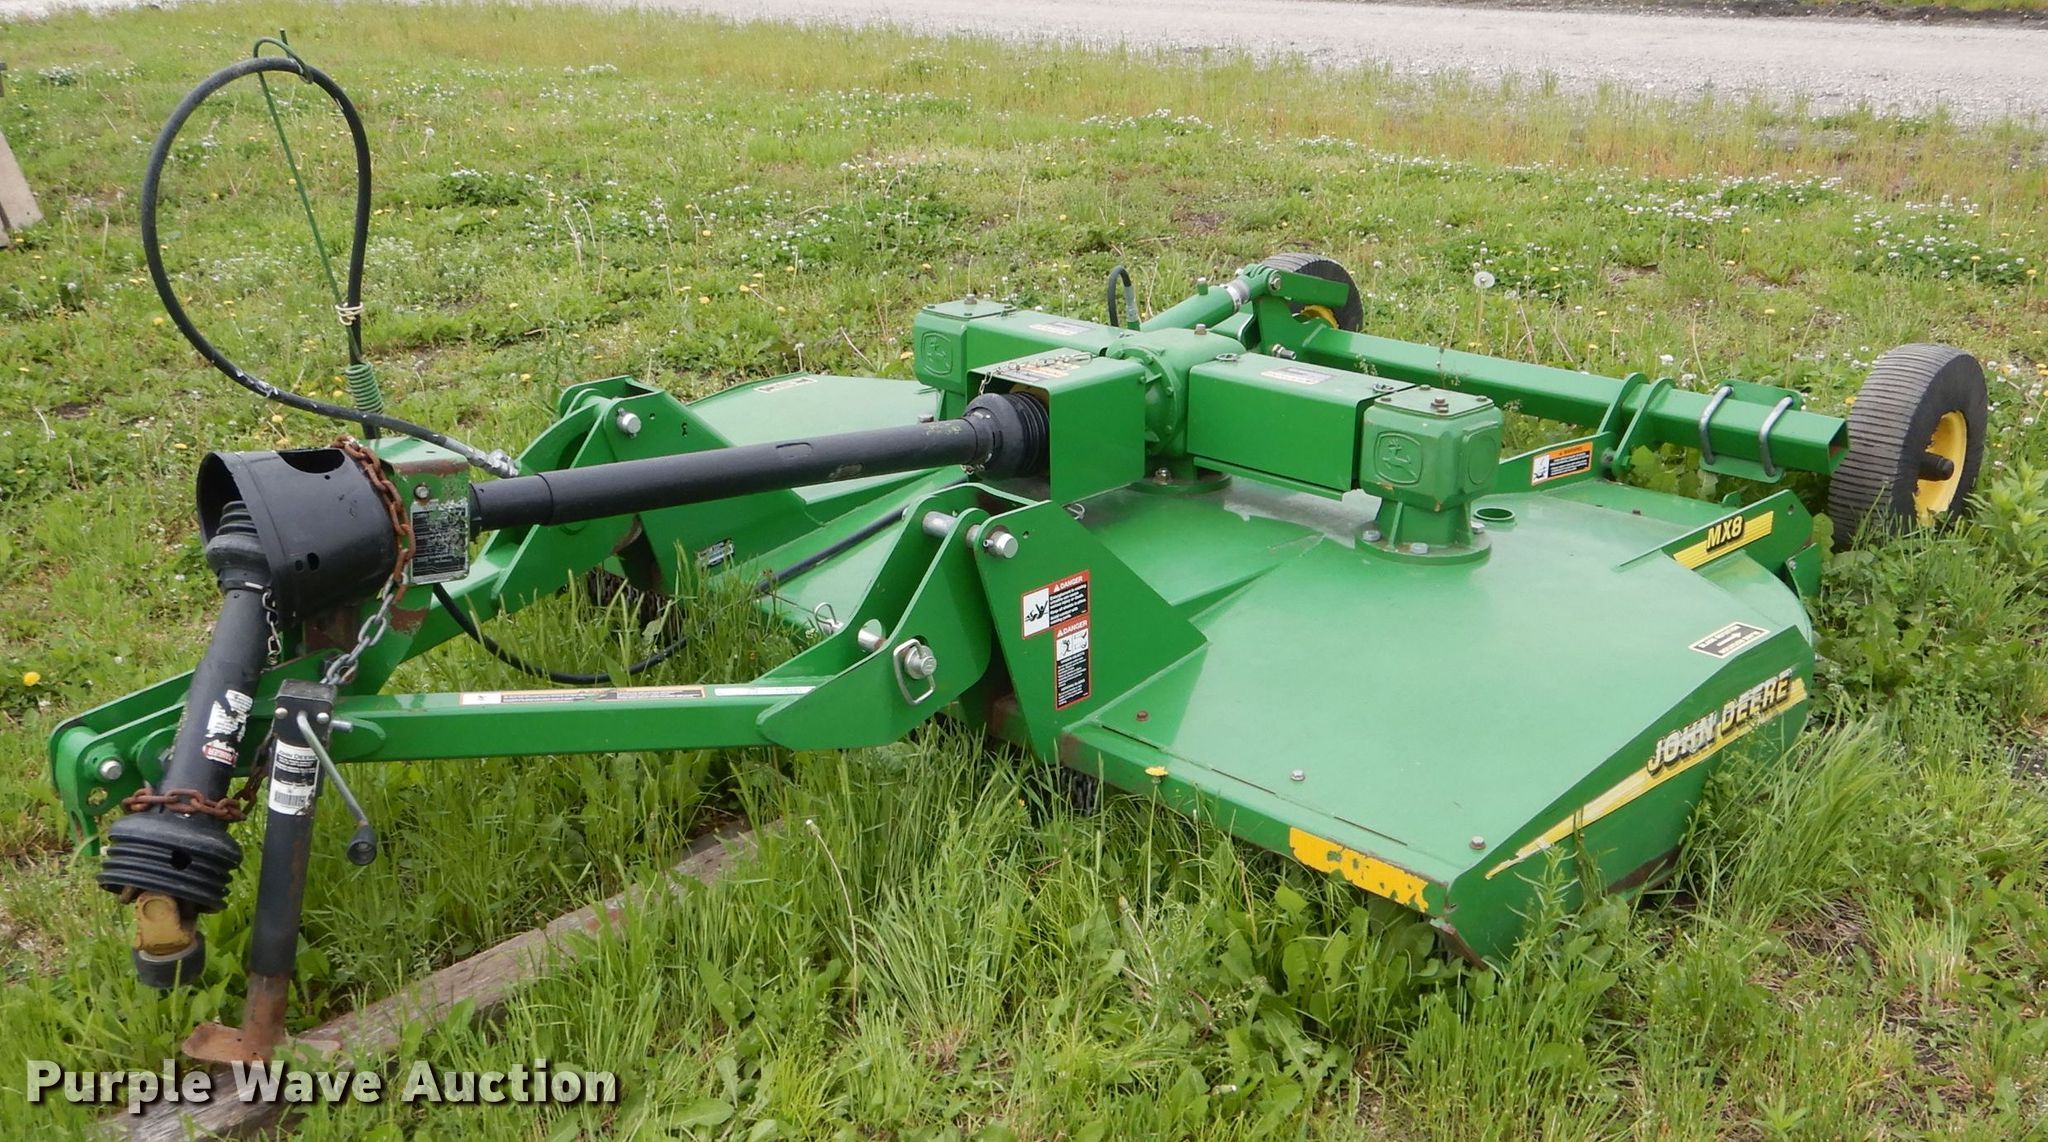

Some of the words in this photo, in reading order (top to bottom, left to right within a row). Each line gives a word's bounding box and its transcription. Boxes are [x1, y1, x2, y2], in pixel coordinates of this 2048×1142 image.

[1706, 515, 1744, 552] MX8
[1060, 575, 1083, 590] DANGER
[1062, 620, 1088, 635] DANGER
[1647, 710, 1717, 776] JOHN
[1720, 667, 1794, 736] DEERE
